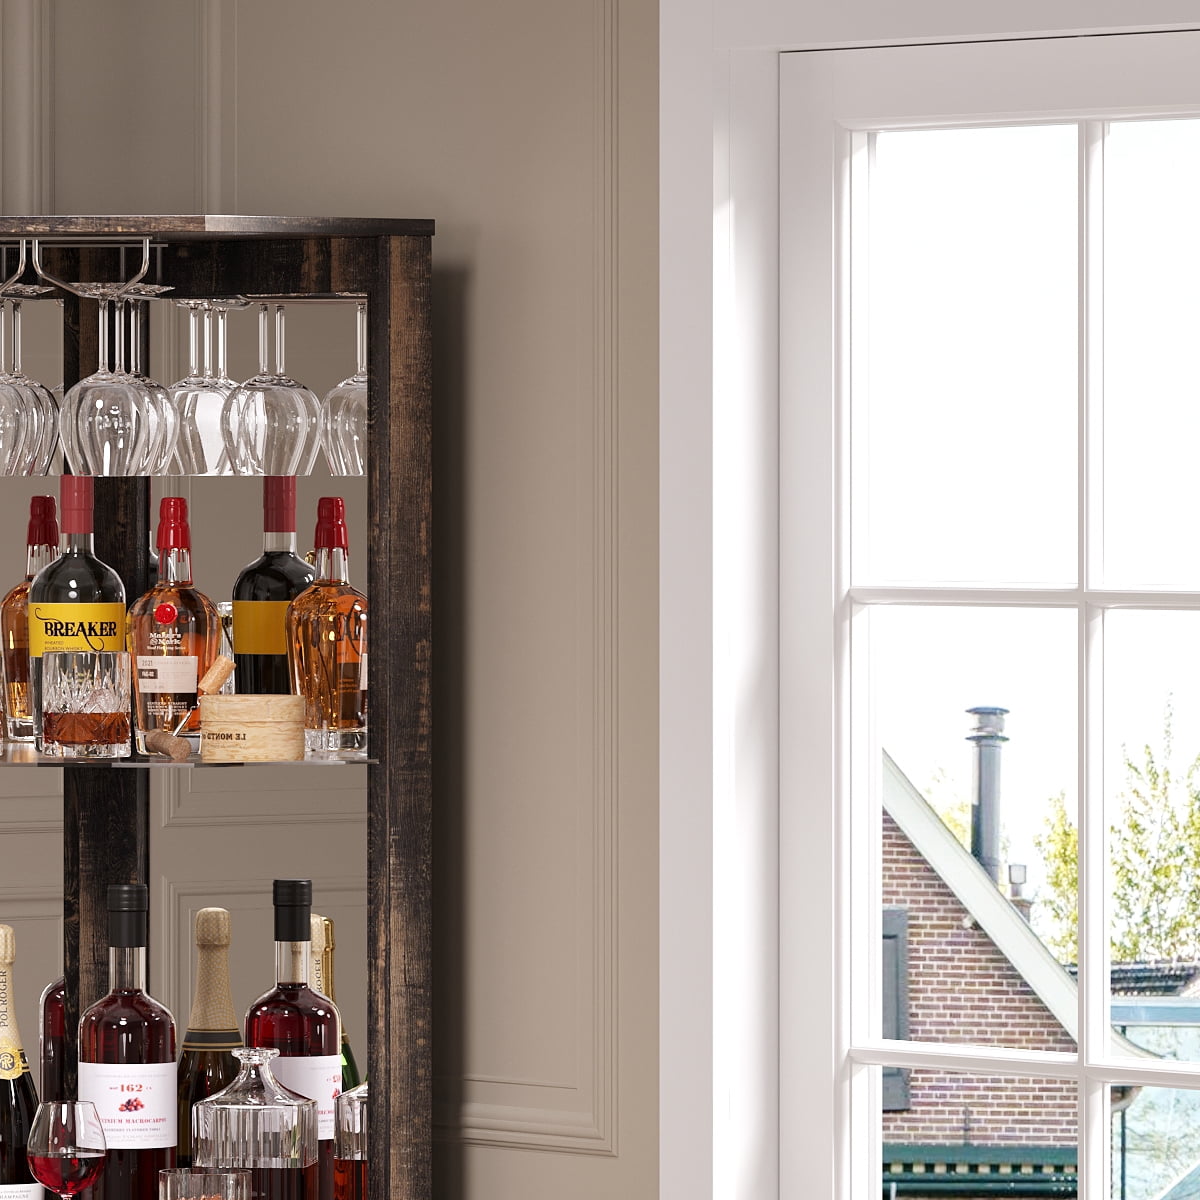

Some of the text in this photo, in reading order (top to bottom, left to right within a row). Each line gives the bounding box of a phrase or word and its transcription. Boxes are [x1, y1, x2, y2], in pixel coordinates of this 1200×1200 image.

[43, 619, 117, 646] BREAKER
[0, 1008, 8, 1027] POL
[120, 1083, 144, 1093] 162
